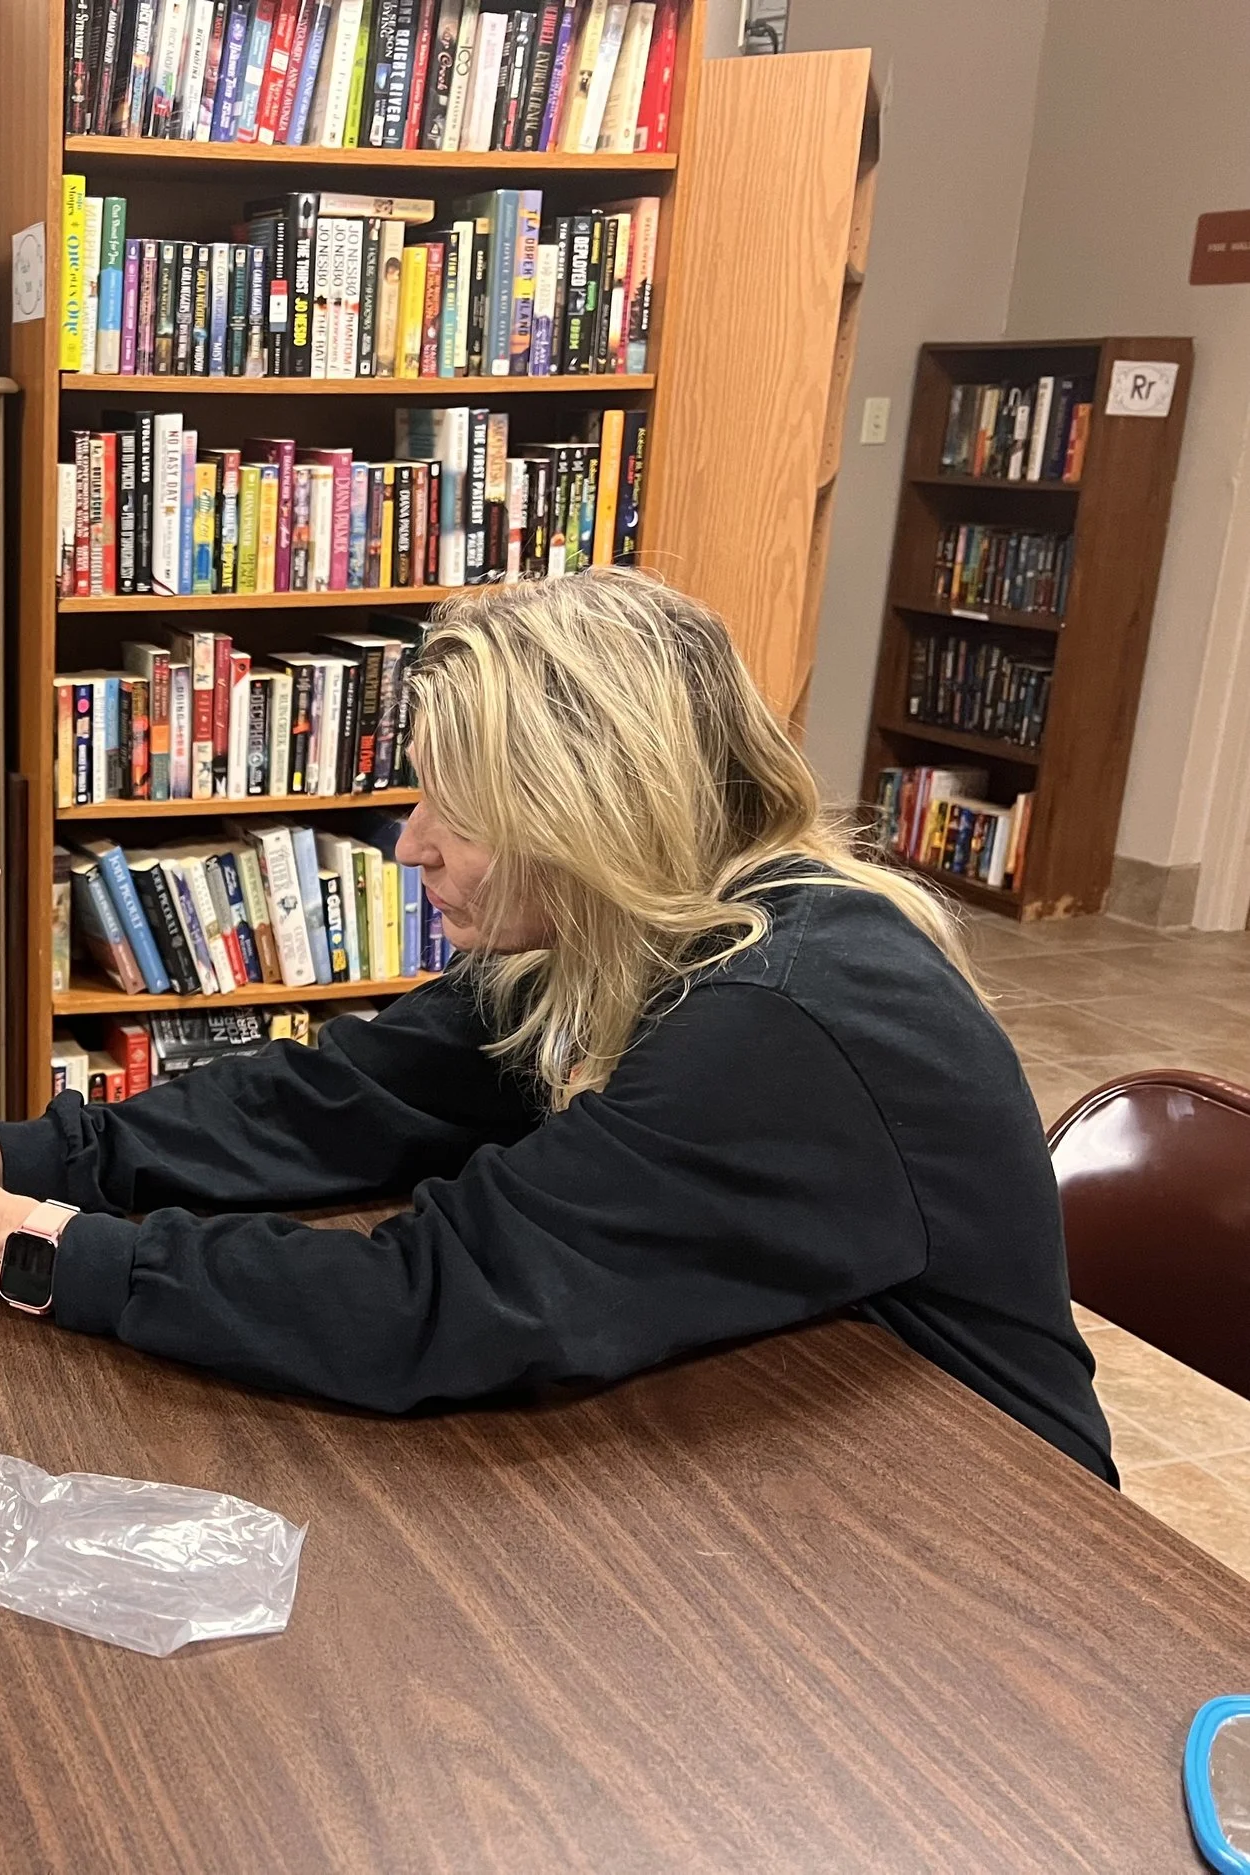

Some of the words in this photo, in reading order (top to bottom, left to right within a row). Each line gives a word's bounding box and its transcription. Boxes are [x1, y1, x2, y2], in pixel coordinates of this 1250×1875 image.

[473, 424, 486, 444] THE
[472, 448, 485, 479] FIRST
[471, 481, 485, 524] PATIENT
